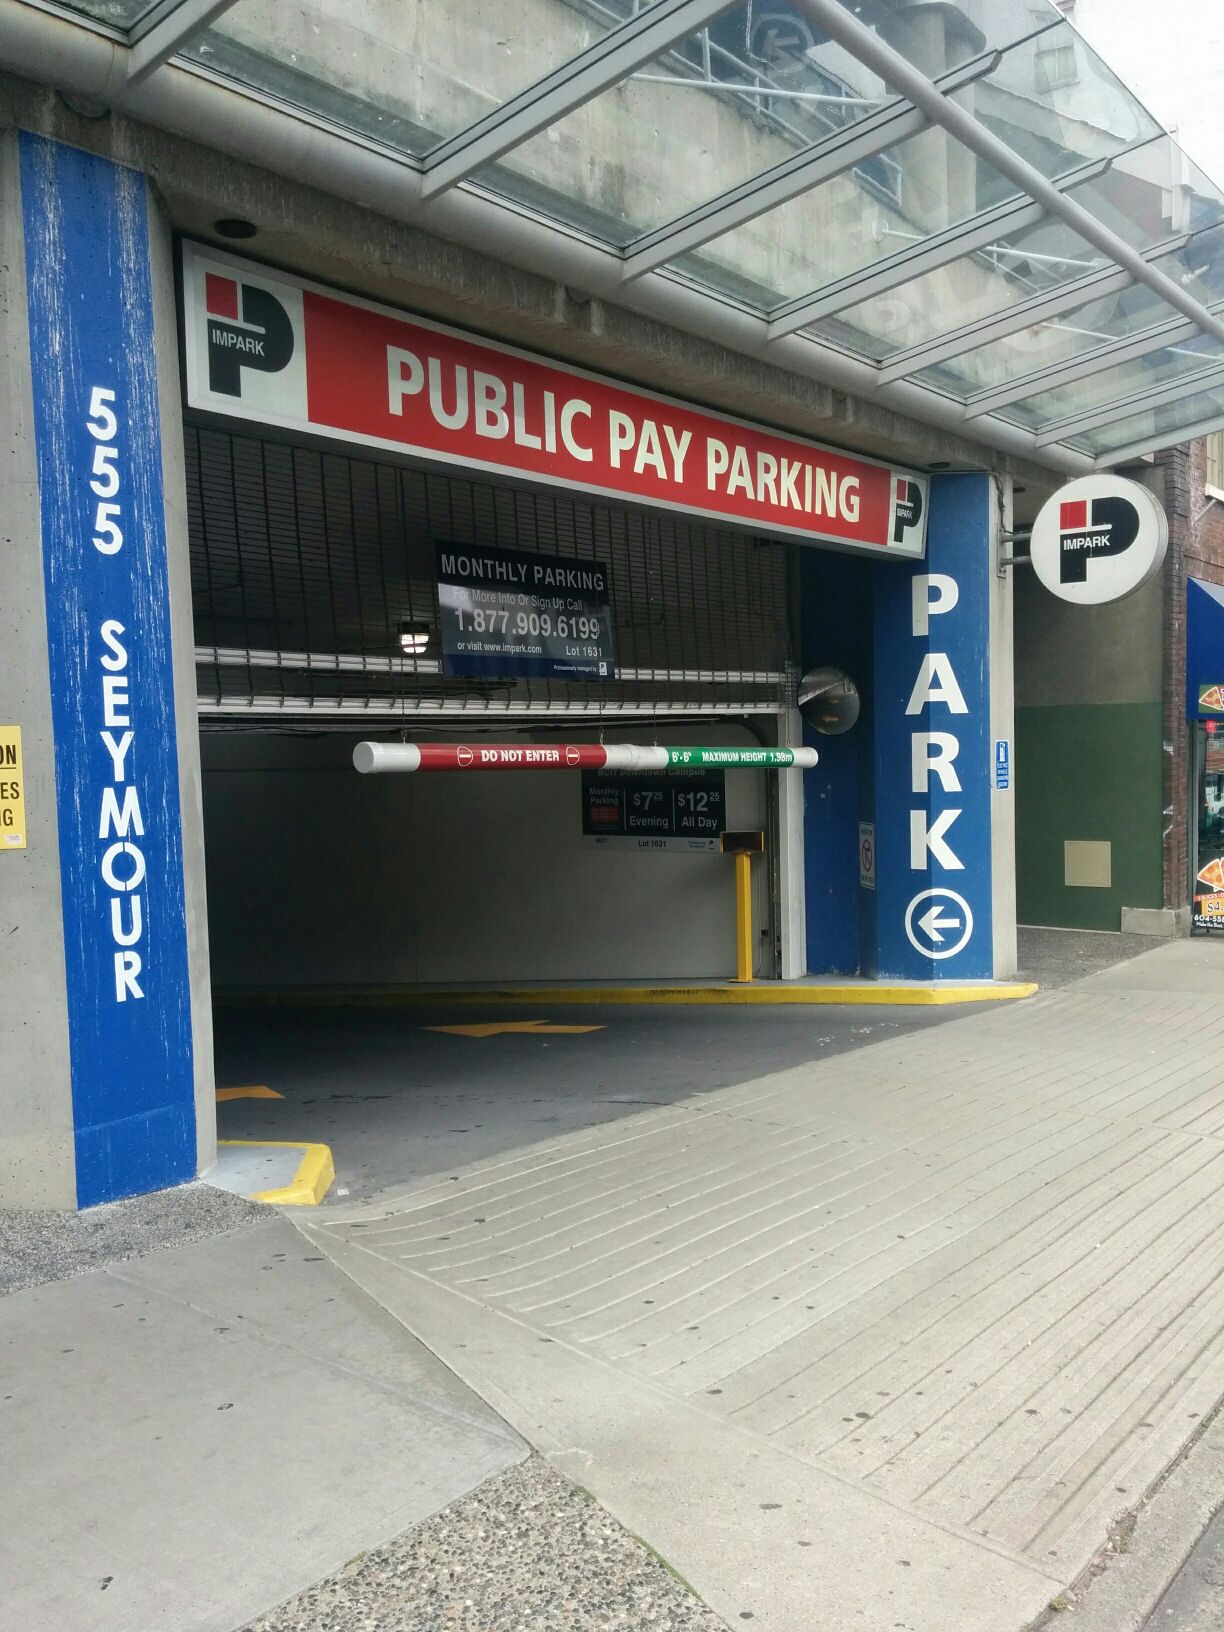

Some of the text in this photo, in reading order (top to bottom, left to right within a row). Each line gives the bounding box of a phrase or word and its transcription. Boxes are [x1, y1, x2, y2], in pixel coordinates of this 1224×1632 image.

[212, 329, 265, 356] IMPARK
[386, 344, 860, 522] PUBLIC PAY PARKING
[1063, 535, 1110, 550] IMPARK
[441, 554, 604, 591] MONTHLY PARKING
[453, 587, 583, 611] For More Info Or Sign Up Call
[455, 607, 600, 640] 1.877.909.6199
[457, 641, 542, 654] or visit www.impark.com
[566, 646, 602, 657] Lot 1631
[904, 574, 969, 870] PARK
[481, 750, 560, 762] DO NOT ENTER
[702, 752, 739, 762] MAXIMUM
[740, 752, 767, 762] HEIGHT
[770, 752, 793, 762] 1.98m
[0, 809, 13, 826] G
[99, 620, 146, 1003] SEYMOUR
[629, 816, 669, 829] Evening
[682, 817, 718, 830] All Day
